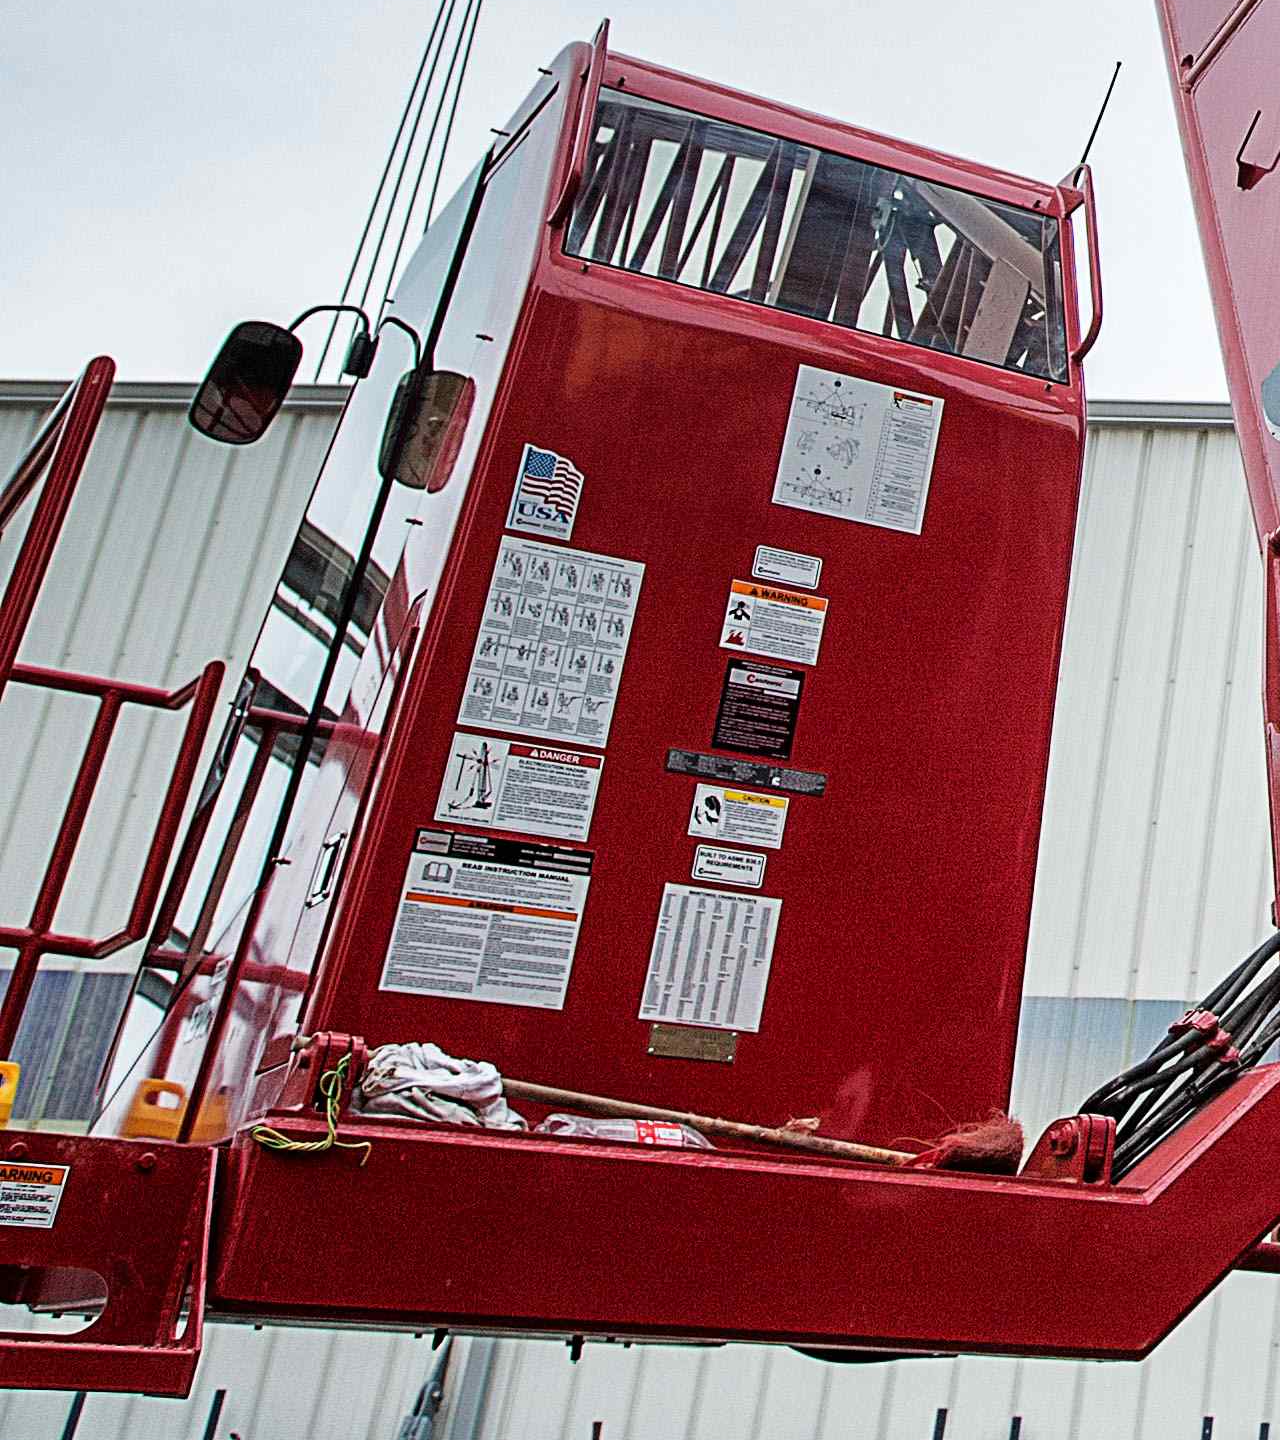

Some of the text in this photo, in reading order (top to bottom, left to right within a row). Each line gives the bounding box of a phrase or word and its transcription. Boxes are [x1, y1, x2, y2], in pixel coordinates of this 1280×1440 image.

[518, 501, 570, 525] USA
[761, 587, 809, 608] WARNING
[539, 750, 580, 765] DANGER
[718, 853, 727, 861] TO
[462, 862, 569, 883] READ INSTRUCTION MANUAL
[0, 1167, 54, 1183] ARNING
